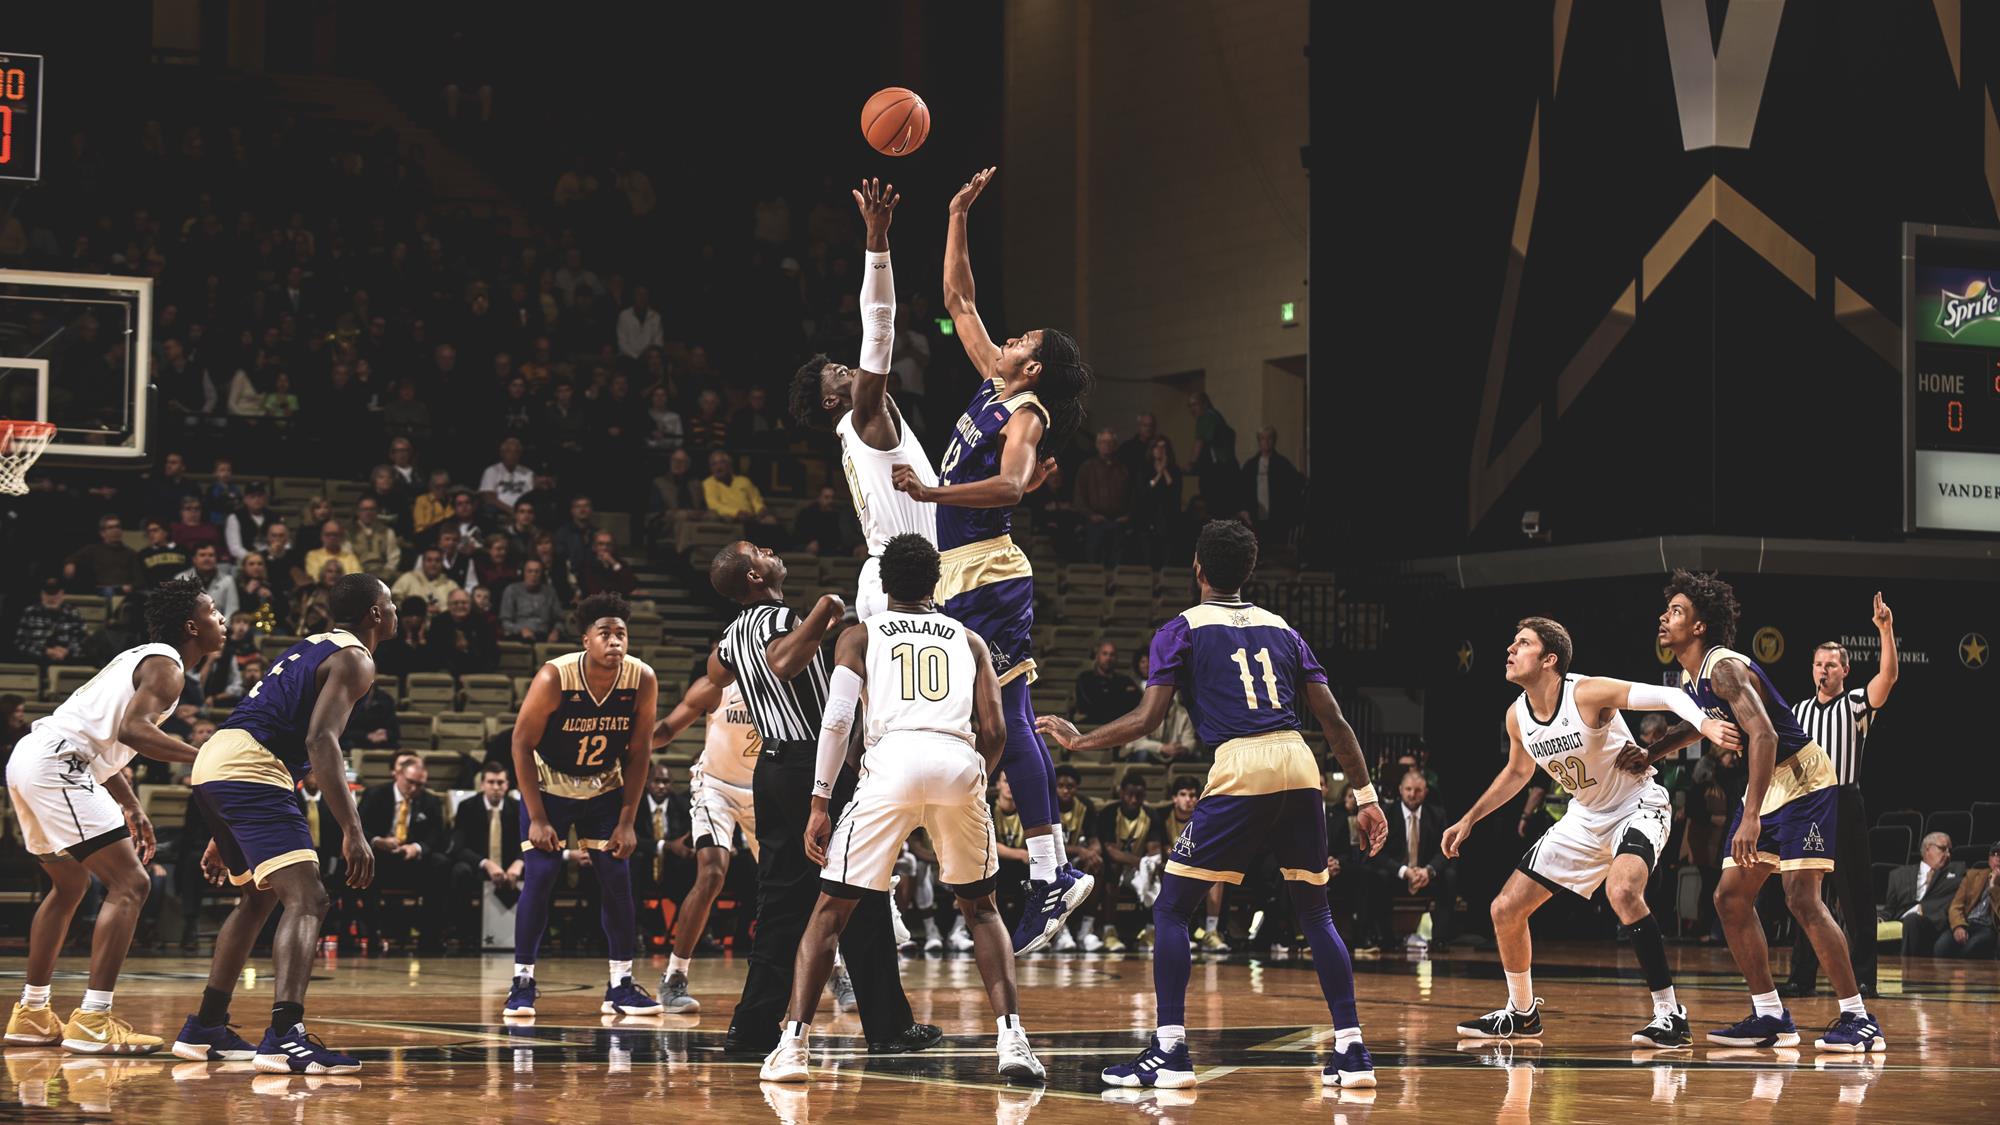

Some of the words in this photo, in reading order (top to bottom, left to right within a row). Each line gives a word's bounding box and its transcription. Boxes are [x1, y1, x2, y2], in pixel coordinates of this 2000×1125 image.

[0, 69, 25, 100] 0
[1944, 291, 1998, 328] Sprite
[1918, 373, 1965, 394] HOME
[1948, 401, 1963, 432] 0
[879, 620, 956, 640] GARLAND
[1841, 634, 1902, 647] BARRT
[891, 642, 950, 701] 10
[1230, 647, 1282, 710] 11
[562, 718, 598, 732] ALCORN
[598, 716, 630, 731] STATE
[576, 735, 607, 766] 12
[1528, 731, 1584, 759] VANDERBILT
[1548, 756, 1598, 790] 32
